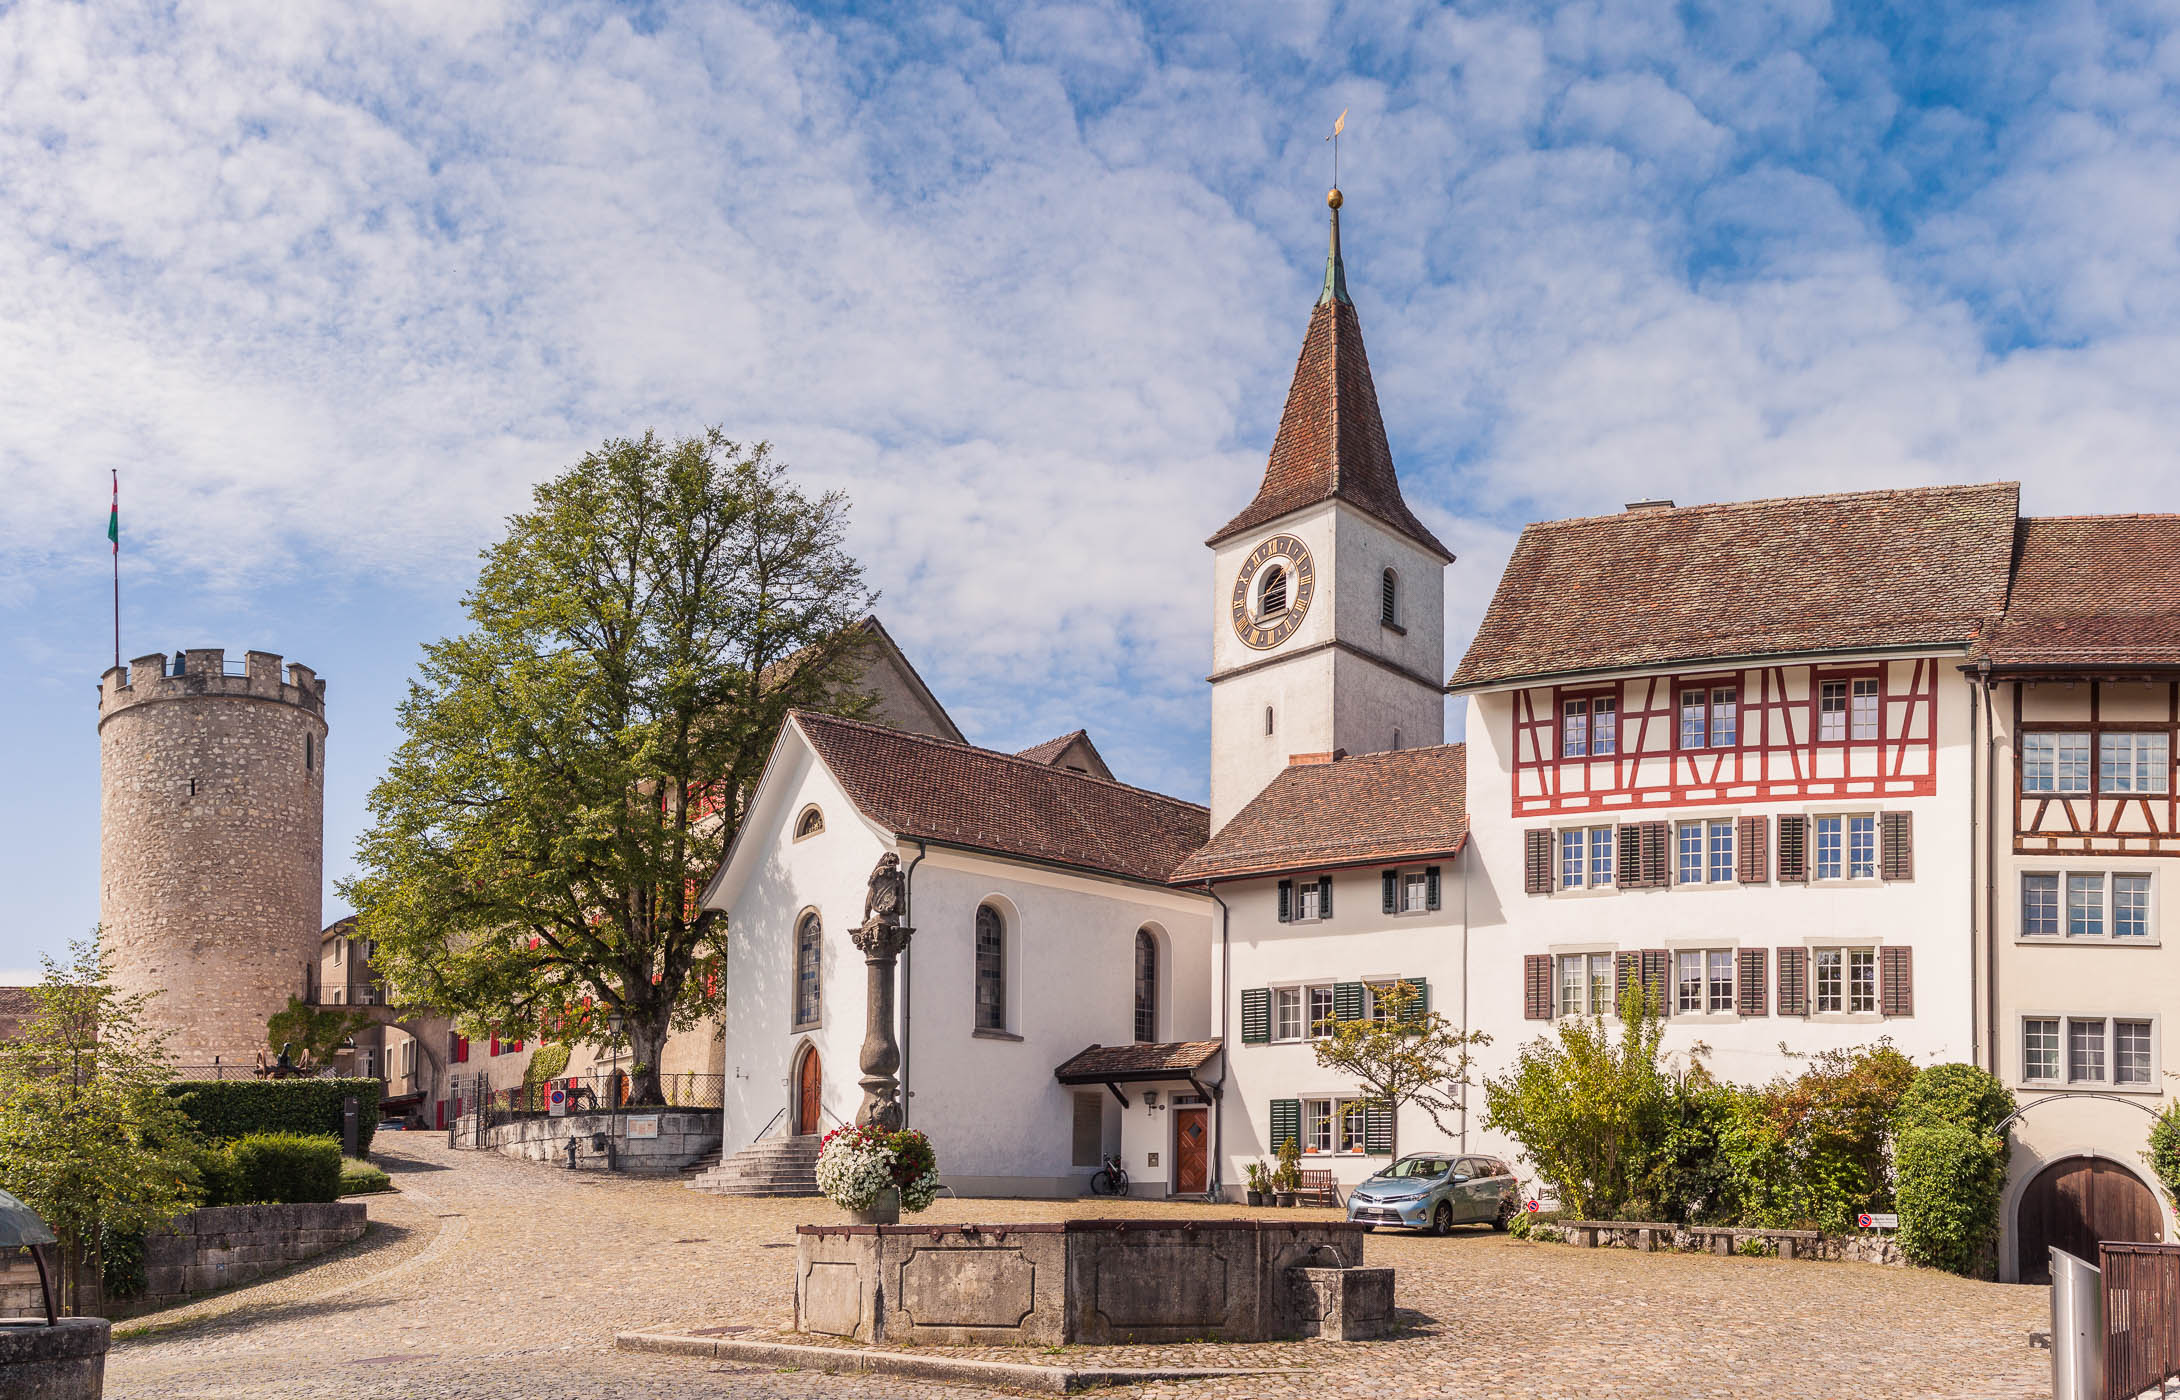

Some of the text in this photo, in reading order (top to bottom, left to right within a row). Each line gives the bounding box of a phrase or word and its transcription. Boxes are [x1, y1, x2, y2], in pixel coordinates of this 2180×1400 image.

[1268, 539, 1278, 556] XII
[1286, 539, 1293, 554] I
[1251, 552, 1261, 567] XI
[1296, 551, 1308, 566] II
[1239, 576, 1249, 585] X
[1300, 574, 1312, 586] III
